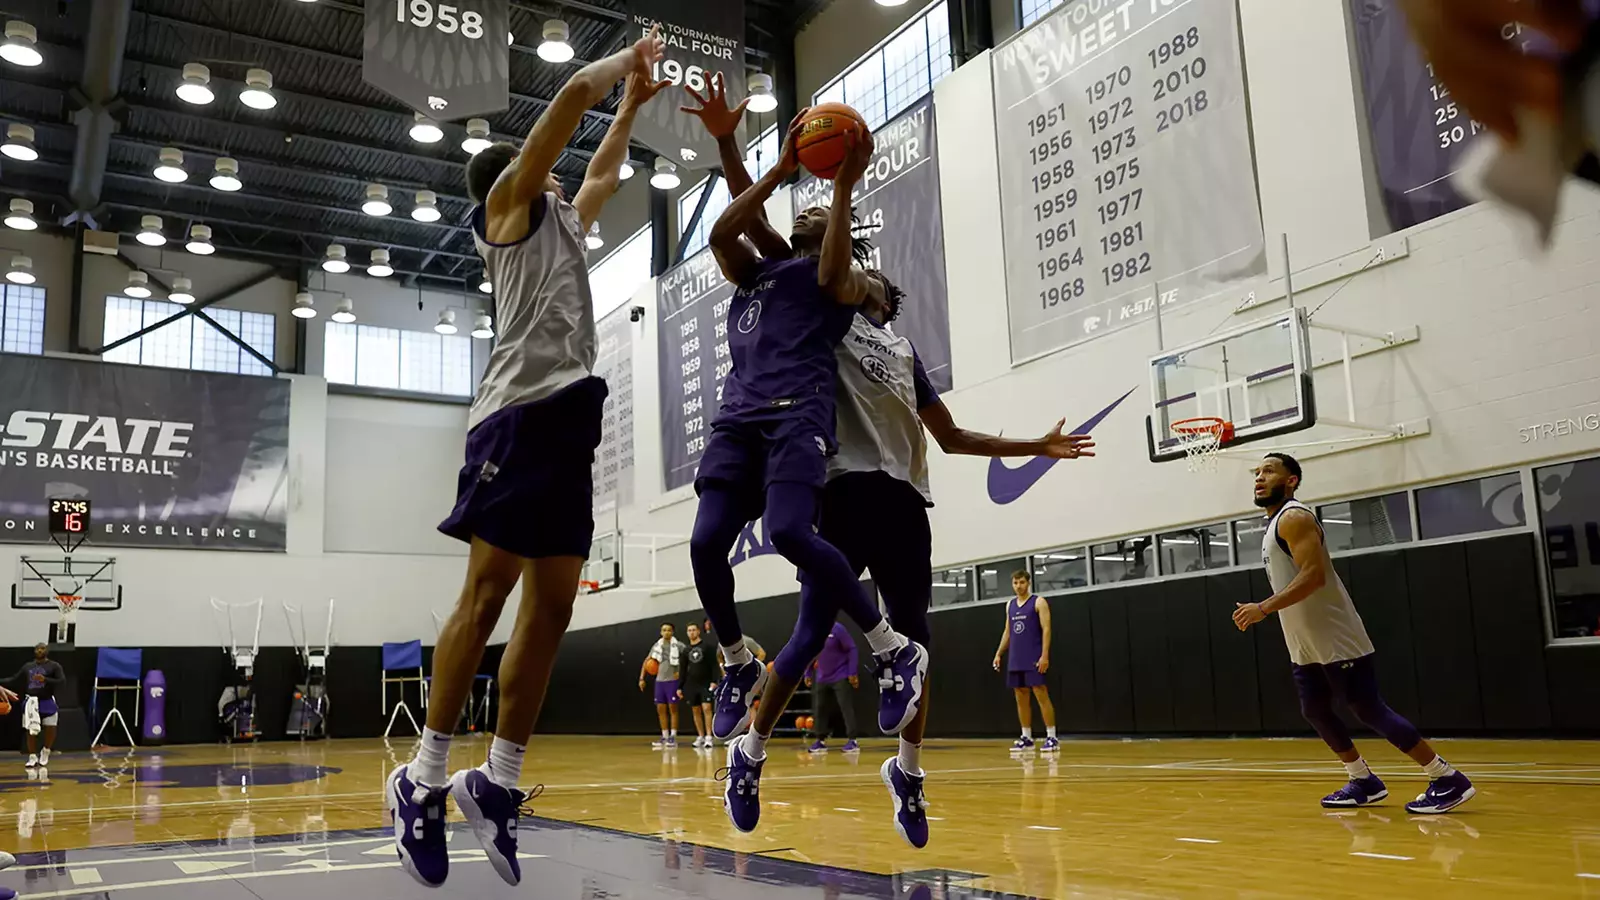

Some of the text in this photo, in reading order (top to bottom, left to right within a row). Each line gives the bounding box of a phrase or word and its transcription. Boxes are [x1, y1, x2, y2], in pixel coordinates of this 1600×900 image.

[397, 0, 484, 39] 1958
[642, 27, 733, 60] FNAL FOUR
[668, 24, 738, 49] TOURNAMENT
[1035, 1, 1135, 84] SWEET
[1027, 26, 1200, 137] 1951 1970 1988
[1029, 56, 1206, 165] 1956 1972 2010
[1435, 102, 1458, 126] 25
[1031, 89, 1208, 194] 1958 1973 2018
[1439, 125, 1465, 149] 30
[863, 137, 920, 190] FOUR
[1033, 157, 1140, 222] 1959 1975
[1035, 188, 1143, 251] 1961 1977
[1037, 221, 1144, 280] 1964 1981
[661, 268, 685, 295] NCAA
[681, 266, 717, 304] ELITE
[1039, 252, 1152, 310] 1968 1982
[680, 316, 698, 338] 1951
[681, 356, 701, 377] 1959
[685, 416, 704, 436] 1972
[1519, 413, 1600, 444] STRENG
[686, 436, 705, 456] 1973
[36, 452, 174, 476] BASKETBALL
[52, 501, 87, 513] 27:45
[65, 513, 81, 531] 16
[106, 523, 256, 538] EXCELLENCE
